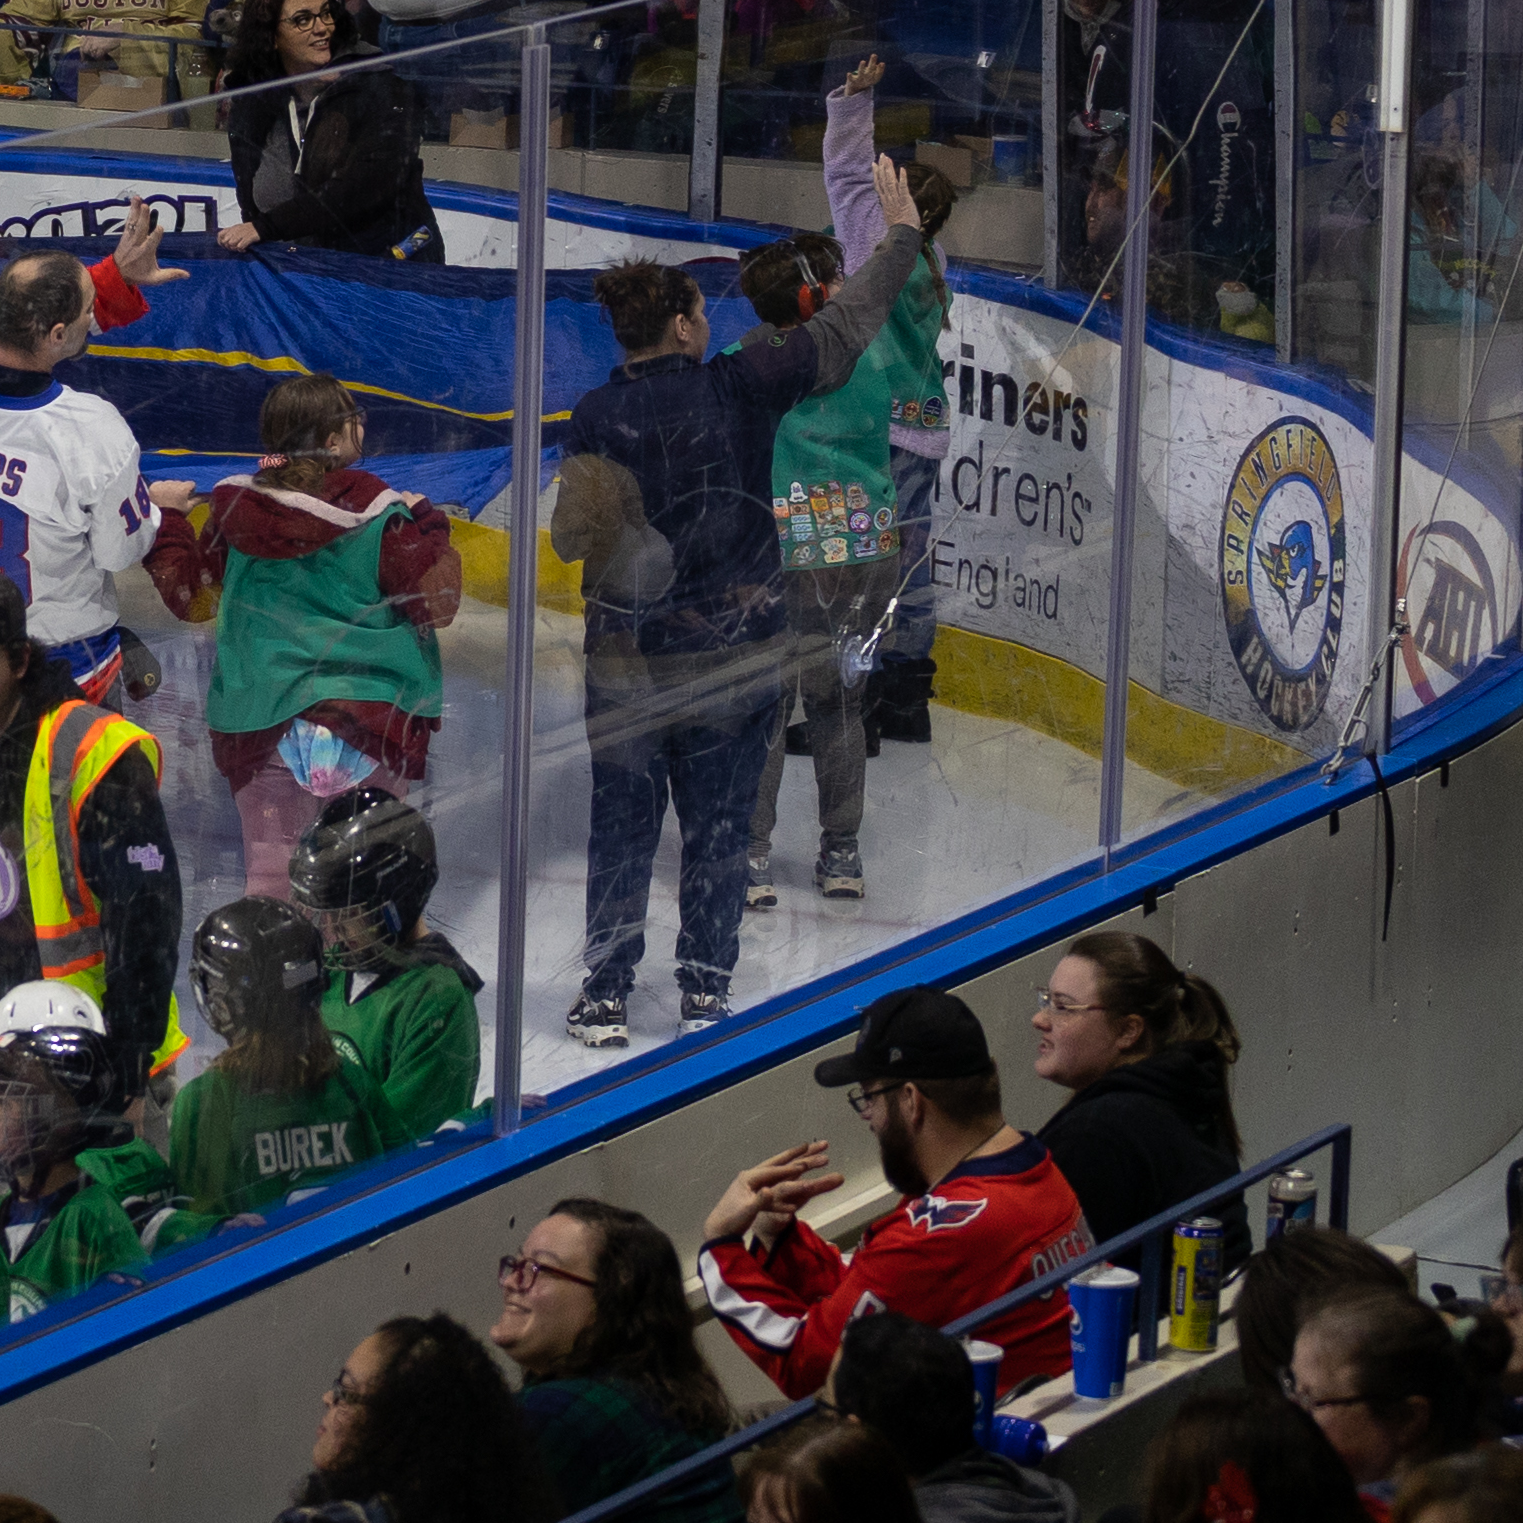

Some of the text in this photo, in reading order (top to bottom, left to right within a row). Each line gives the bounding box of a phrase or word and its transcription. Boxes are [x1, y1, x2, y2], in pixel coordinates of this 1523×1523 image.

[118, 474, 152, 537] 18
[1226, 428, 1340, 587] SPRINGFIELD
[930, 537, 1060, 621] England
[1412, 555, 1490, 682] AHL
[1241, 635, 1318, 722] HOCKEY
[256, 1121, 353, 1176] BUREK
